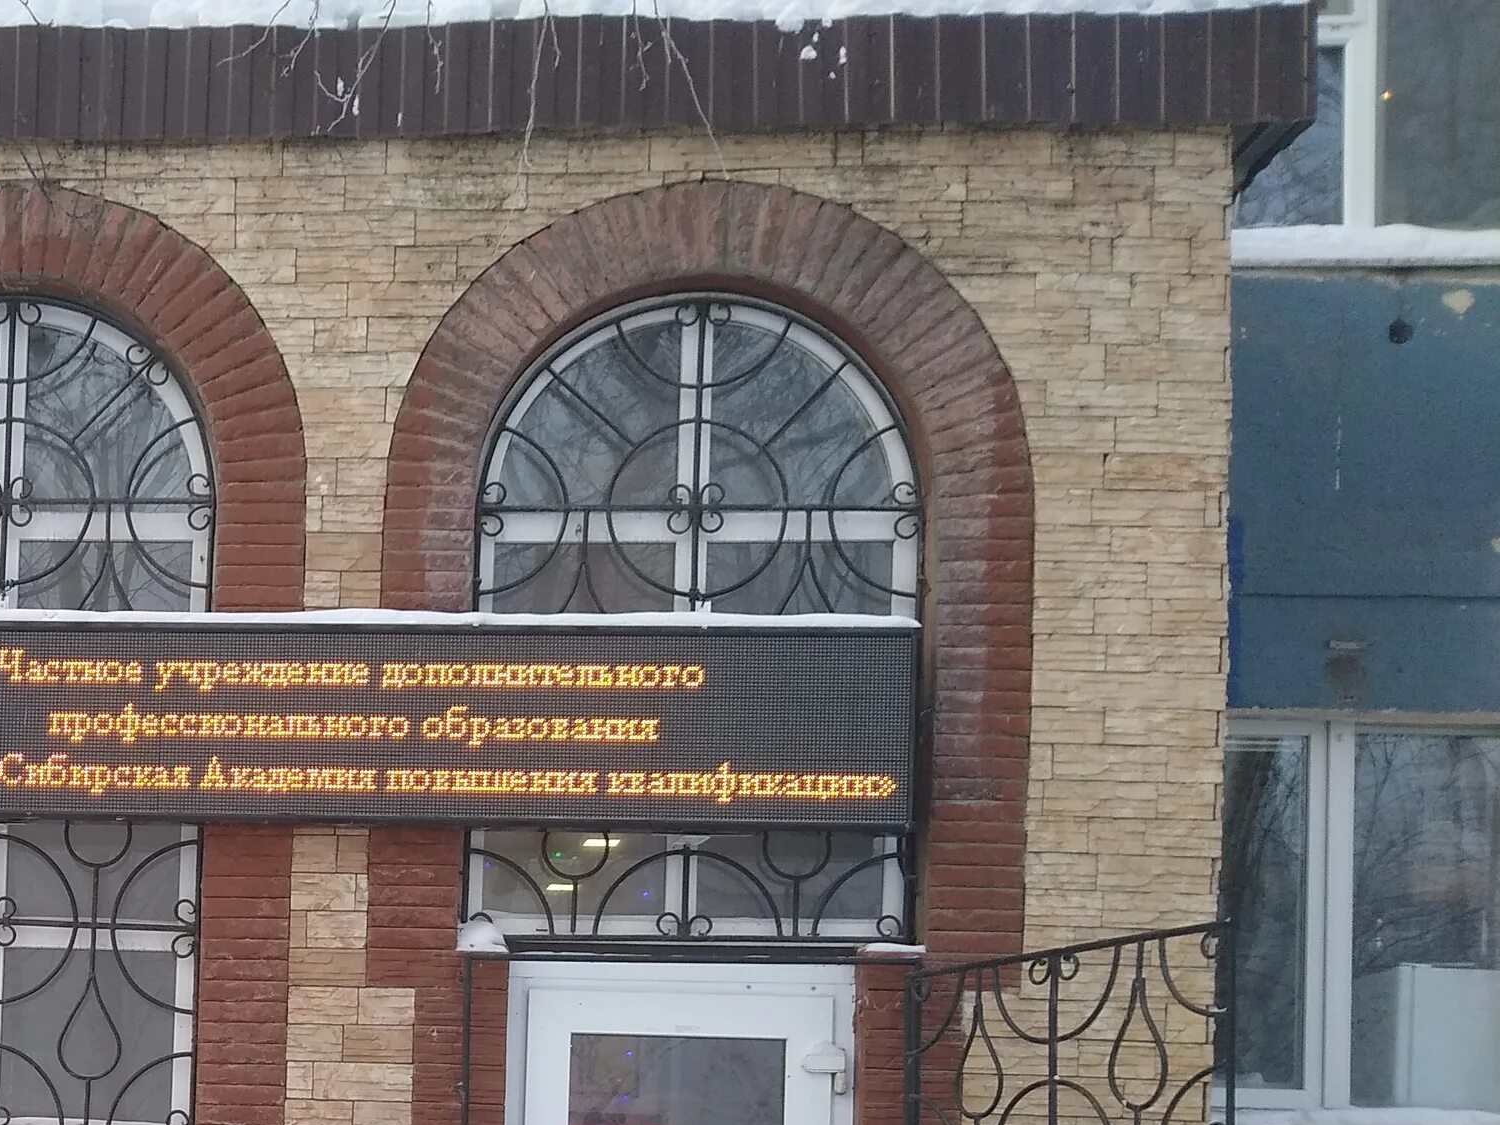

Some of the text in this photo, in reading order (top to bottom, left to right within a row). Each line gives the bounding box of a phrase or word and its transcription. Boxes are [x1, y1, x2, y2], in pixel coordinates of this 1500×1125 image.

[153, 660, 371, 693] учреждение
[380, 661, 705, 690] дополнительного
[47, 700, 661, 748] профессионального образования
[198, 755, 379, 794] Академии
[384, 768, 599, 796] повышения
